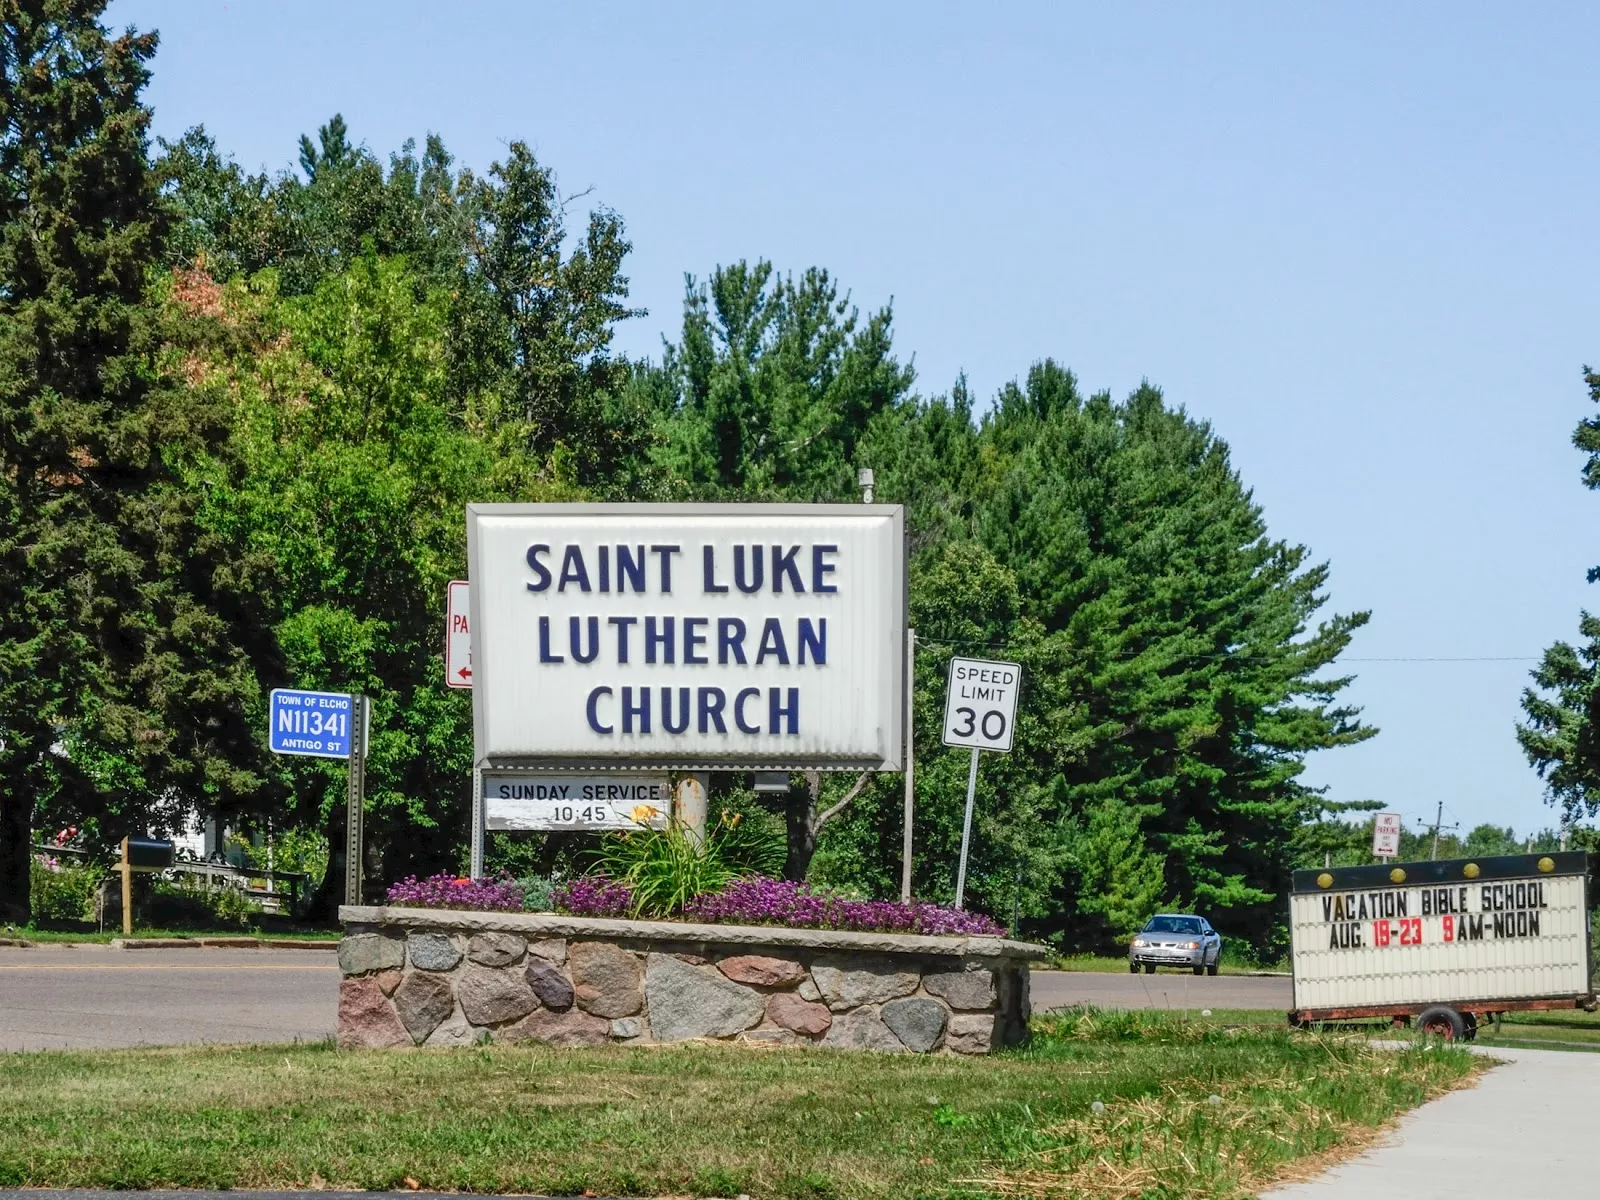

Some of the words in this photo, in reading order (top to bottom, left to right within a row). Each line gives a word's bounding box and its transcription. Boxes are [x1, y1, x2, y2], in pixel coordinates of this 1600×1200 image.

[526, 544, 680, 593] SAINT
[703, 545, 839, 593] LUKE
[538, 616, 828, 665] LUTHERAN
[956, 667, 1014, 685] SPEED
[277, 695, 301, 706] TOWN
[304, 698, 317, 707] OF
[319, 699, 348, 709] ELCHO
[961, 685, 1006, 702] LIMIT
[278, 708, 346, 737] N11341
[586, 686, 800, 735] CHURCH
[952, 707, 1006, 741] 30
[281, 738, 322, 750] ANTIGO
[327, 742, 341, 752] ST
[499, 785, 570, 801] SUNDAY
[582, 785, 661, 801] SERVICE
[554, 806, 606, 822] 10:45
[1322, 891, 1407, 922] VACATION
[1421, 887, 1468, 915] BIBLE
[1481, 882, 1548, 912] SCHOOL
[1330, 922, 1366, 949] AUG.
